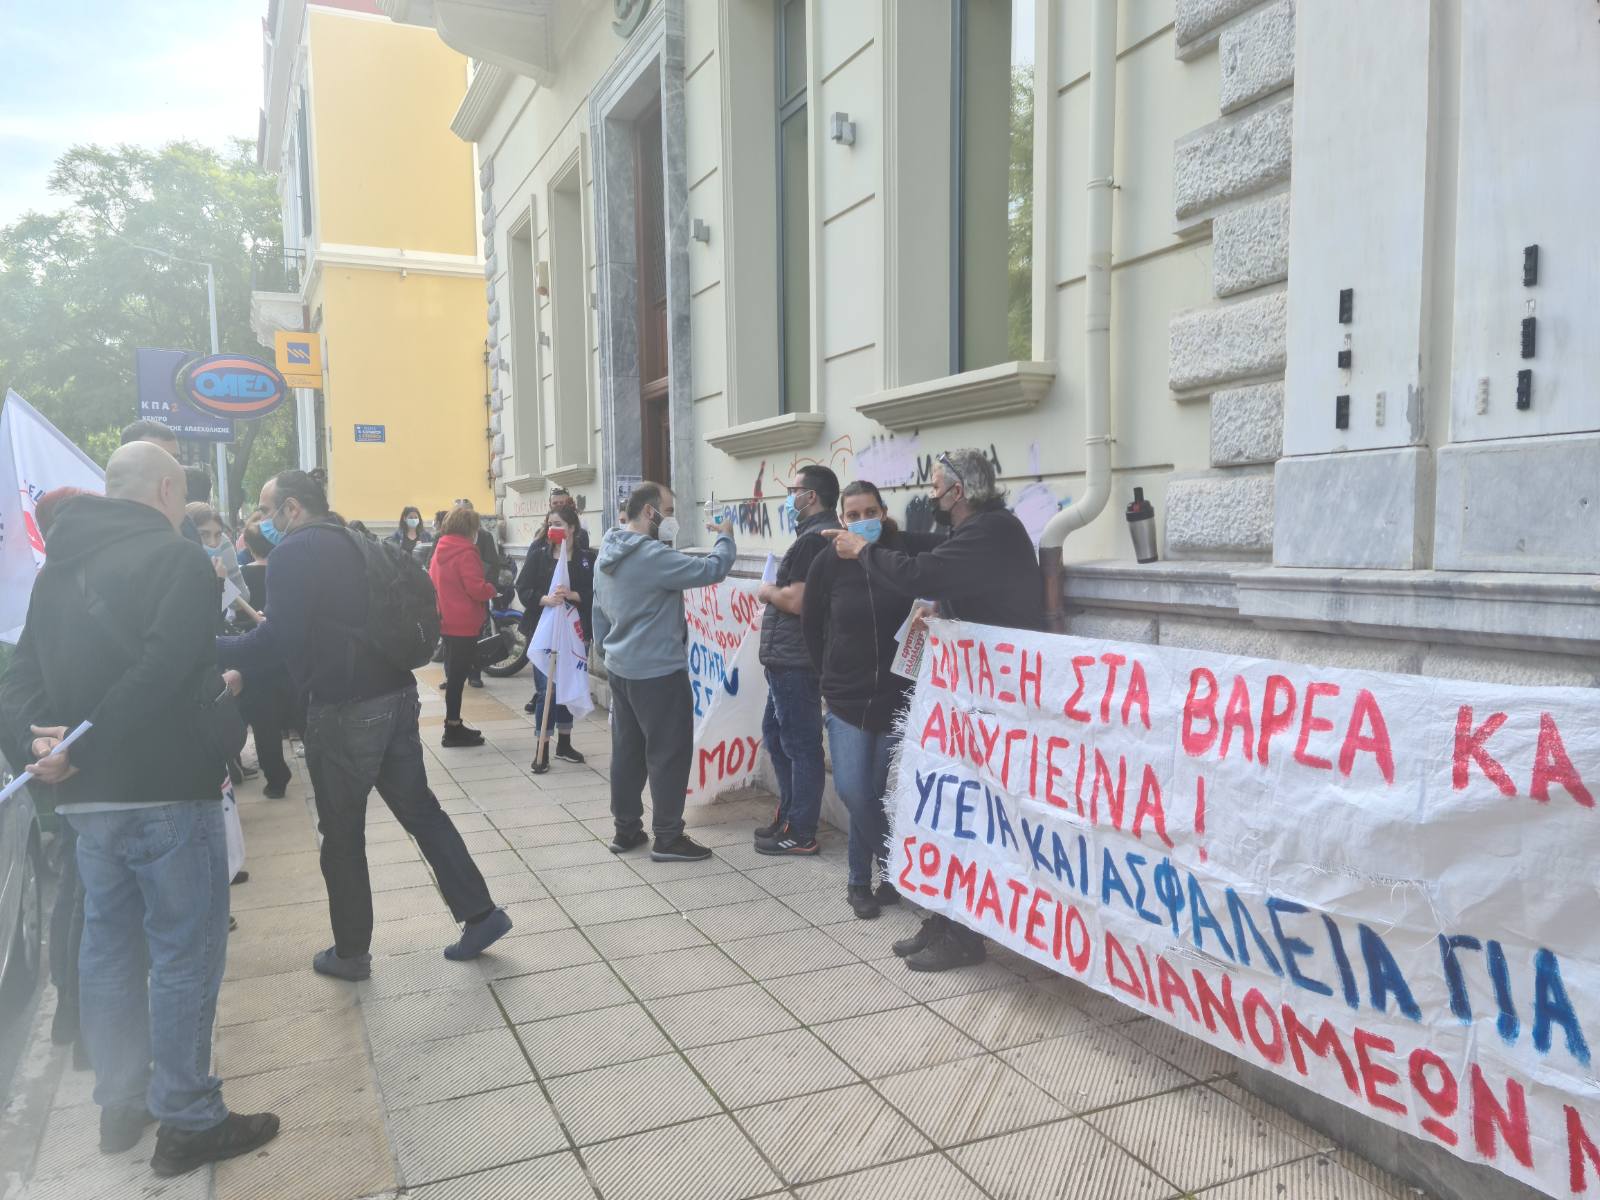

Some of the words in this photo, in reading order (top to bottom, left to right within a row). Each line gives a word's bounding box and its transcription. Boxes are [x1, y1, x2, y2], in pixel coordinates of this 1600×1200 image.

[195, 372, 276, 398] ΟΑΕΔ
[1064, 653, 1152, 731] ΣΤΑ
[1181, 667, 1395, 786] ΒΑΡΕΑ
[899, 836, 1091, 975] ΣΩΜΑΤΕΙΟ
[1105, 929, 1534, 1170] ΔΙΑΝΟΜΕΩΝ
[914, 769, 1019, 851] ΥΓΕΙΑ
[1021, 818, 1088, 895] ΚΑΙ
[1102, 847, 1422, 1024] ΑΣΦΑΛΕΙΑ
[1439, 933, 1592, 1068] ΓΙΑ
